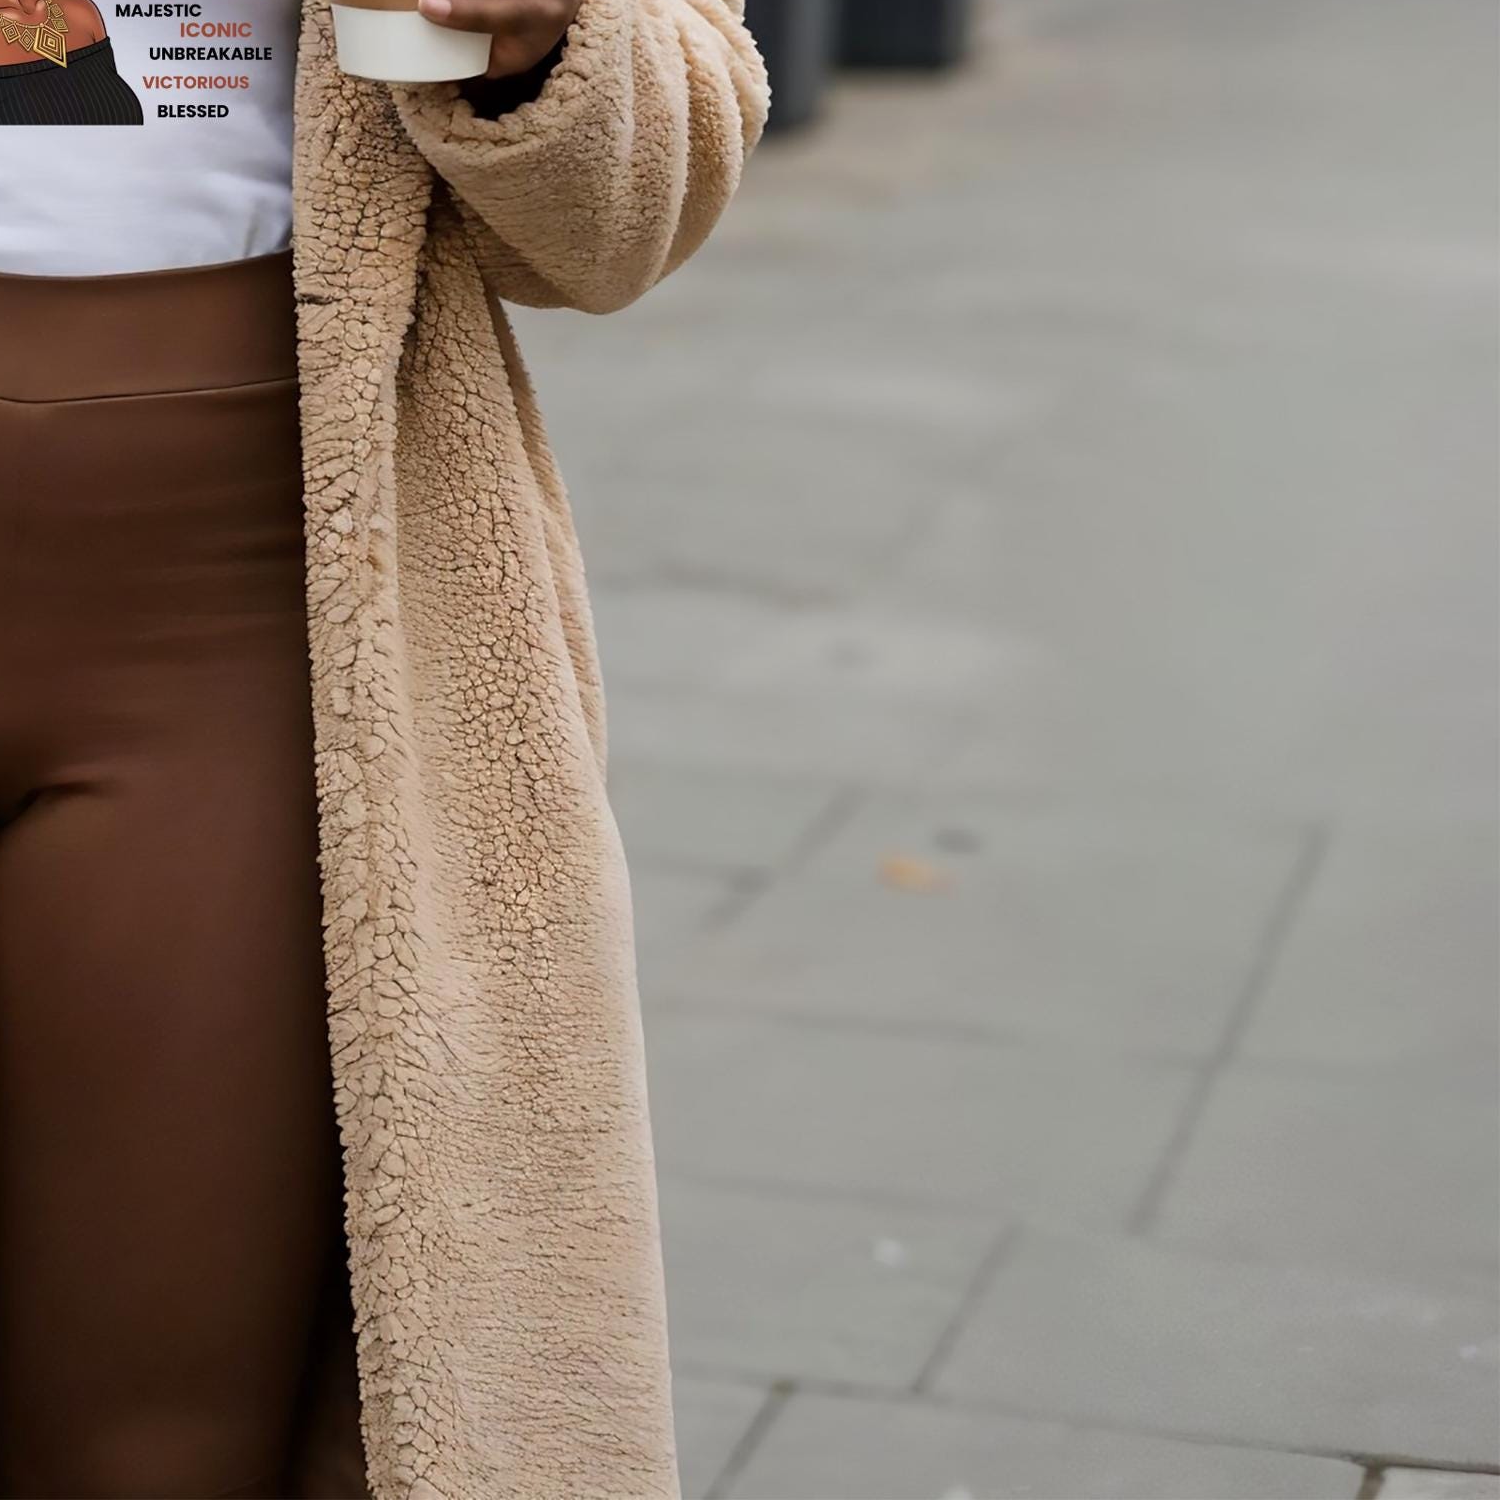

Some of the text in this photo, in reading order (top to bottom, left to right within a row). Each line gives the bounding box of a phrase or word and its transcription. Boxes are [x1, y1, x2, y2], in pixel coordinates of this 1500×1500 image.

[115, 3, 202, 18] MAJESTIC
[179, 22, 253, 38] ICONIC
[149, 46, 273, 61] UNBREAKABLE
[142, 75, 250, 90] VICTORIOUS
[157, 104, 230, 118] BLESSED
